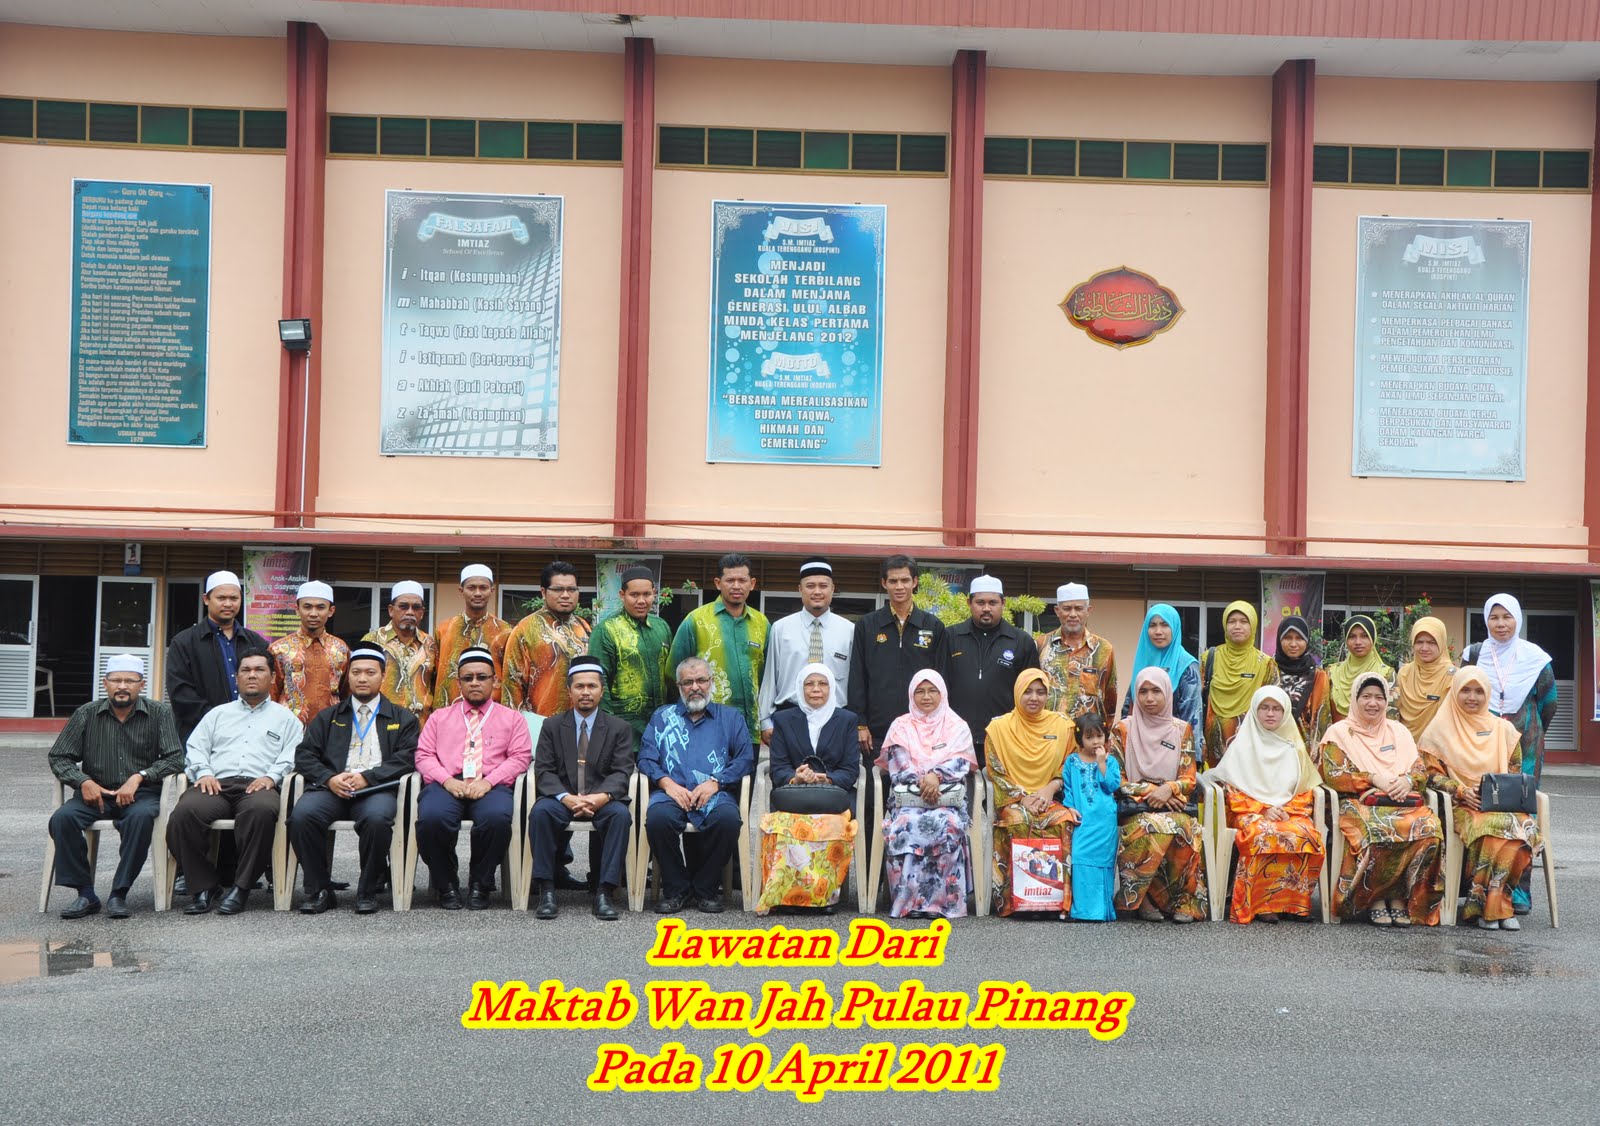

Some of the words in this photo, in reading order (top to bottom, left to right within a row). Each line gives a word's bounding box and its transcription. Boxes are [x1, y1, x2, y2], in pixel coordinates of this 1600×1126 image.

[436, 216, 512, 233] FALSAFAH
[782, 220, 819, 234] VISI
[458, 240, 489, 248] IMTIAZ
[797, 239, 815, 247] IMTIAZ
[1422, 239, 1470, 256] MISI
[770, 261, 825, 272] MENJADI
[421, 269, 445, 282] Itqan
[450, 270, 521, 285] (Kesungguhan)
[735, 273, 788, 285] SEKOLAH
[795, 275, 861, 286] TERBILANG
[744, 288, 786, 299] DALAM
[792, 289, 851, 300] MENJANA
[1383, 291, 1437, 300] MENERAPKAN
[1441, 292, 1472, 301] AKHLAK
[420, 297, 468, 310] Mahabbah
[474, 298, 504, 311] (Kasih
[507, 299, 545, 314] Sayang)
[728, 302, 787, 313] GENERASI
[793, 304, 822, 314] ULUL
[828, 304, 866, 315] ALBAB
[1382, 301, 1409, 309] DALAM
[1413, 302, 1443, 310] SEGALA
[1447, 302, 1480, 311] AKTIVITI
[724, 315, 765, 326] MINDA
[770, 317, 809, 328] KELAS
[814, 318, 869, 329] PERTAMA
[1382, 317, 1437, 327] MEMPERKASA
[1481, 320, 1513, 329] BAHASA
[419, 324, 449, 339] Taqwa
[454, 325, 478, 339] (Taat
[482, 327, 516, 340] kepada
[521, 327, 549, 341] Allah)
[741, 330, 814, 342] MENJELANG
[820, 331, 852, 343] 2012
[1381, 328, 1408, 336] DALAM
[1412, 328, 1471, 337] PEMEROLEHAN
[1474, 329, 1495, 338] ILMU
[1381, 337, 1437, 347] PENGETAHUAN
[1441, 338, 1457, 347] DAN
[1460, 339, 1514, 349] KOMUNIKASI.
[418, 352, 466, 366] Istiqamah
[471, 353, 534, 368] (Berterusan)
[1381, 354, 1439, 364] MEWUJUDKAN
[1442, 356, 1500, 365] PERSEKITARAN
[1380, 365, 1445, 374] PEMBELAJARAN
[1449, 366, 1469, 375] YANG
[1472, 367, 1513, 376] KONDUSIF.
[418, 379, 450, 392] Akhlak
[455, 380, 480, 394] (Budi
[484, 381, 524, 396] Pekerti)
[1380, 381, 1435, 390] MENERAPKAN
[1438, 382, 1469, 391] BUDAYA
[1472, 383, 1495, 392] CINTA
[781, 396, 868, 408] MEREALISASIKAN
[1380, 391, 1403, 399] AKAN
[1405, 392, 1425, 400] ILMU
[1428, 392, 1476, 401] SEPANJANG
[1479, 393, 1504, 402] HAYAT.
[462, 408, 525, 423] (Kepimpinan)
[755, 410, 792, 420] BUDAYA
[797, 411, 834, 423] TAQWA,
[1380, 408, 1434, 417] MENERAPKAN
[1438, 409, 1468, 418] BUDAYA
[1471, 410, 1497, 419] KERJA
[760, 424, 799, 434] HIKMAH
[804, 424, 824, 435] DAN
[1380, 418, 1432, 427] BERPASUKAN
[1435, 419, 1451, 428] DAN
[1455, 420, 1511, 429] MUSYAWARAH
[1379, 428, 1407, 436] DALAM
[1410, 429, 1453, 437] KALANGAN
[1456, 430, 1485, 438] WARGA
[1379, 438, 1417, 447] SEKOLAH.
[128, 544, 138, 563] 1
[1024, 886, 1052, 896] imtiaz
